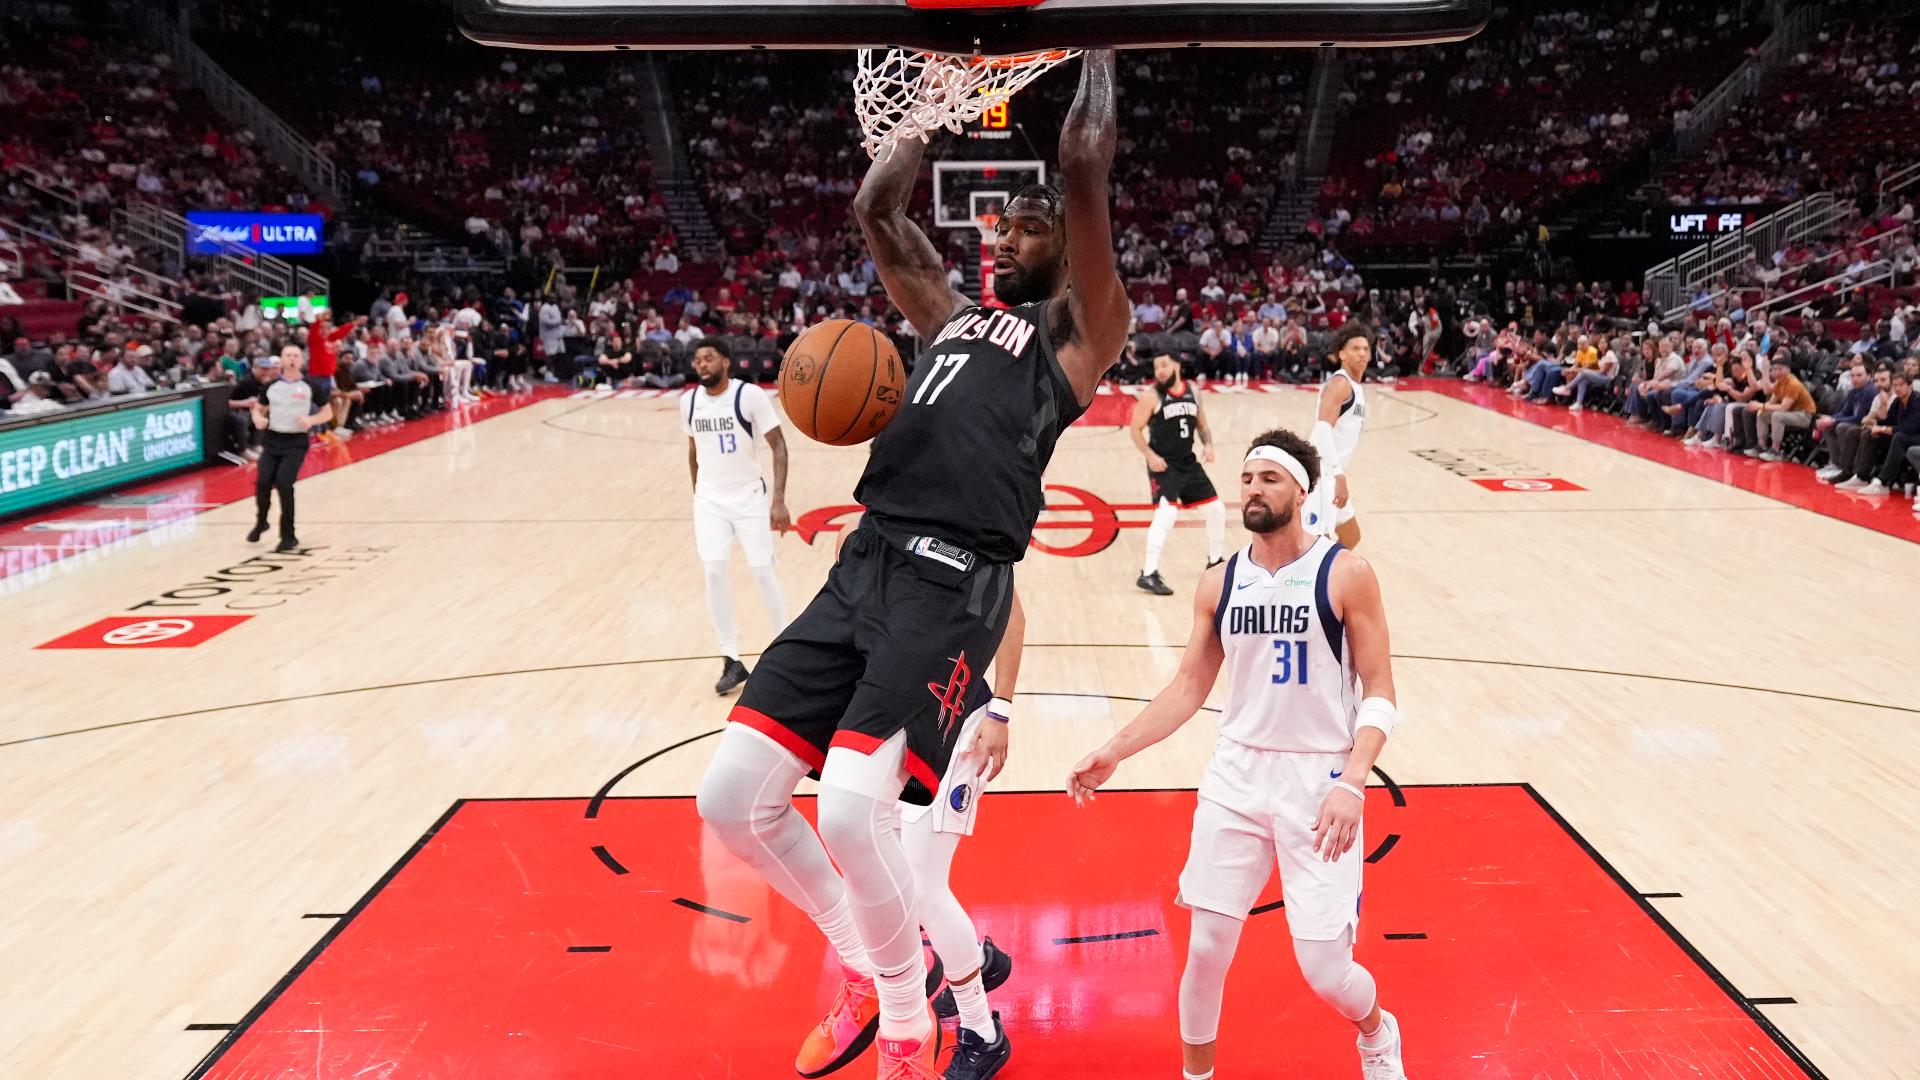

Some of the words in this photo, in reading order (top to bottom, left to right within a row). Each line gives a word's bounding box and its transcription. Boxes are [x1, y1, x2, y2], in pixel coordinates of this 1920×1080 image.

[262, 225, 317, 242] ULTRA
[912, 353, 970, 405] 17
[695, 417, 734, 433] DALLAS
[1179, 418, 1189, 439] 5
[719, 433, 737, 454] 13
[1284, 577, 1312, 587] chime
[1230, 605, 1309, 635] DALLAS
[1272, 640, 1308, 685] 31
